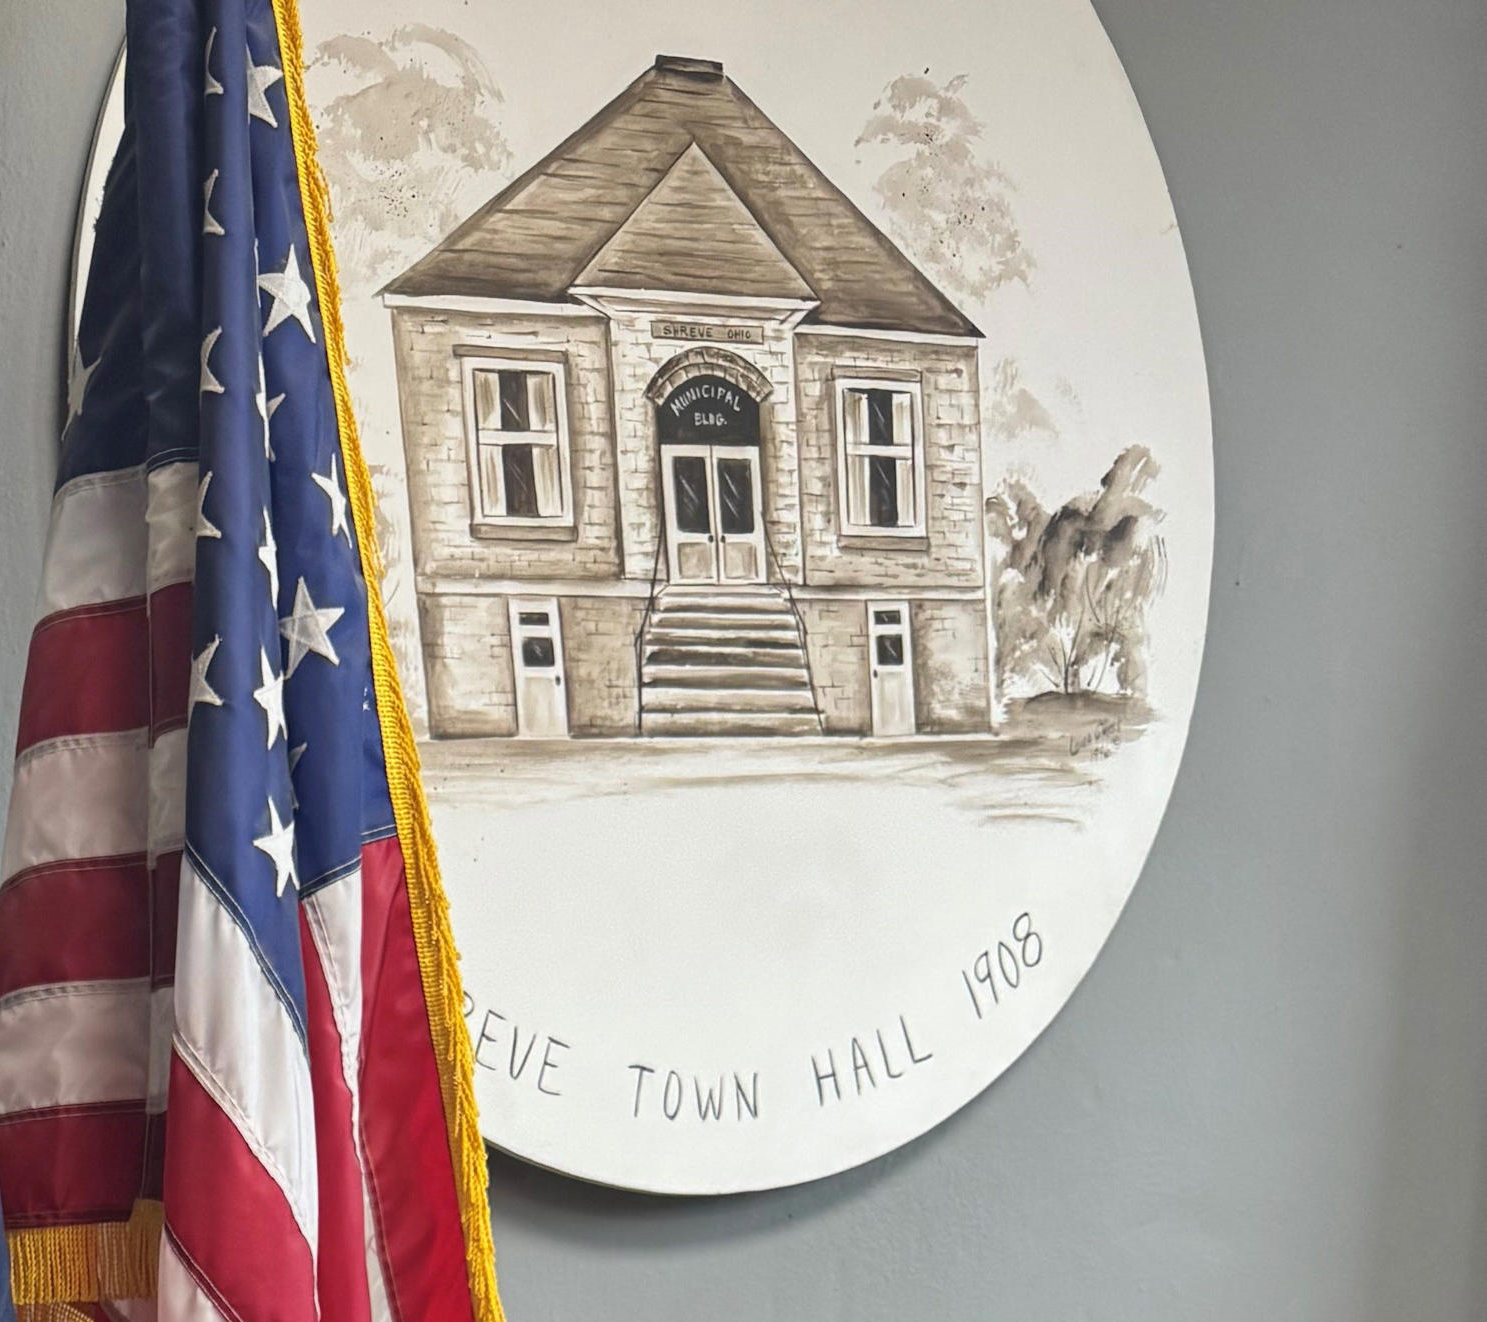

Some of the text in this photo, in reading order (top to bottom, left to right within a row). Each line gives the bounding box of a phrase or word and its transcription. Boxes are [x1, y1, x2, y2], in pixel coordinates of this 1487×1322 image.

[662, 325, 752, 340] SHREVE OHIO
[669, 384, 741, 417] MUNICIPAL
[628, 1064, 759, 1122] TOWN
[811, 1014, 934, 1107] HALL
[961, 911, 1044, 1020] 1908
